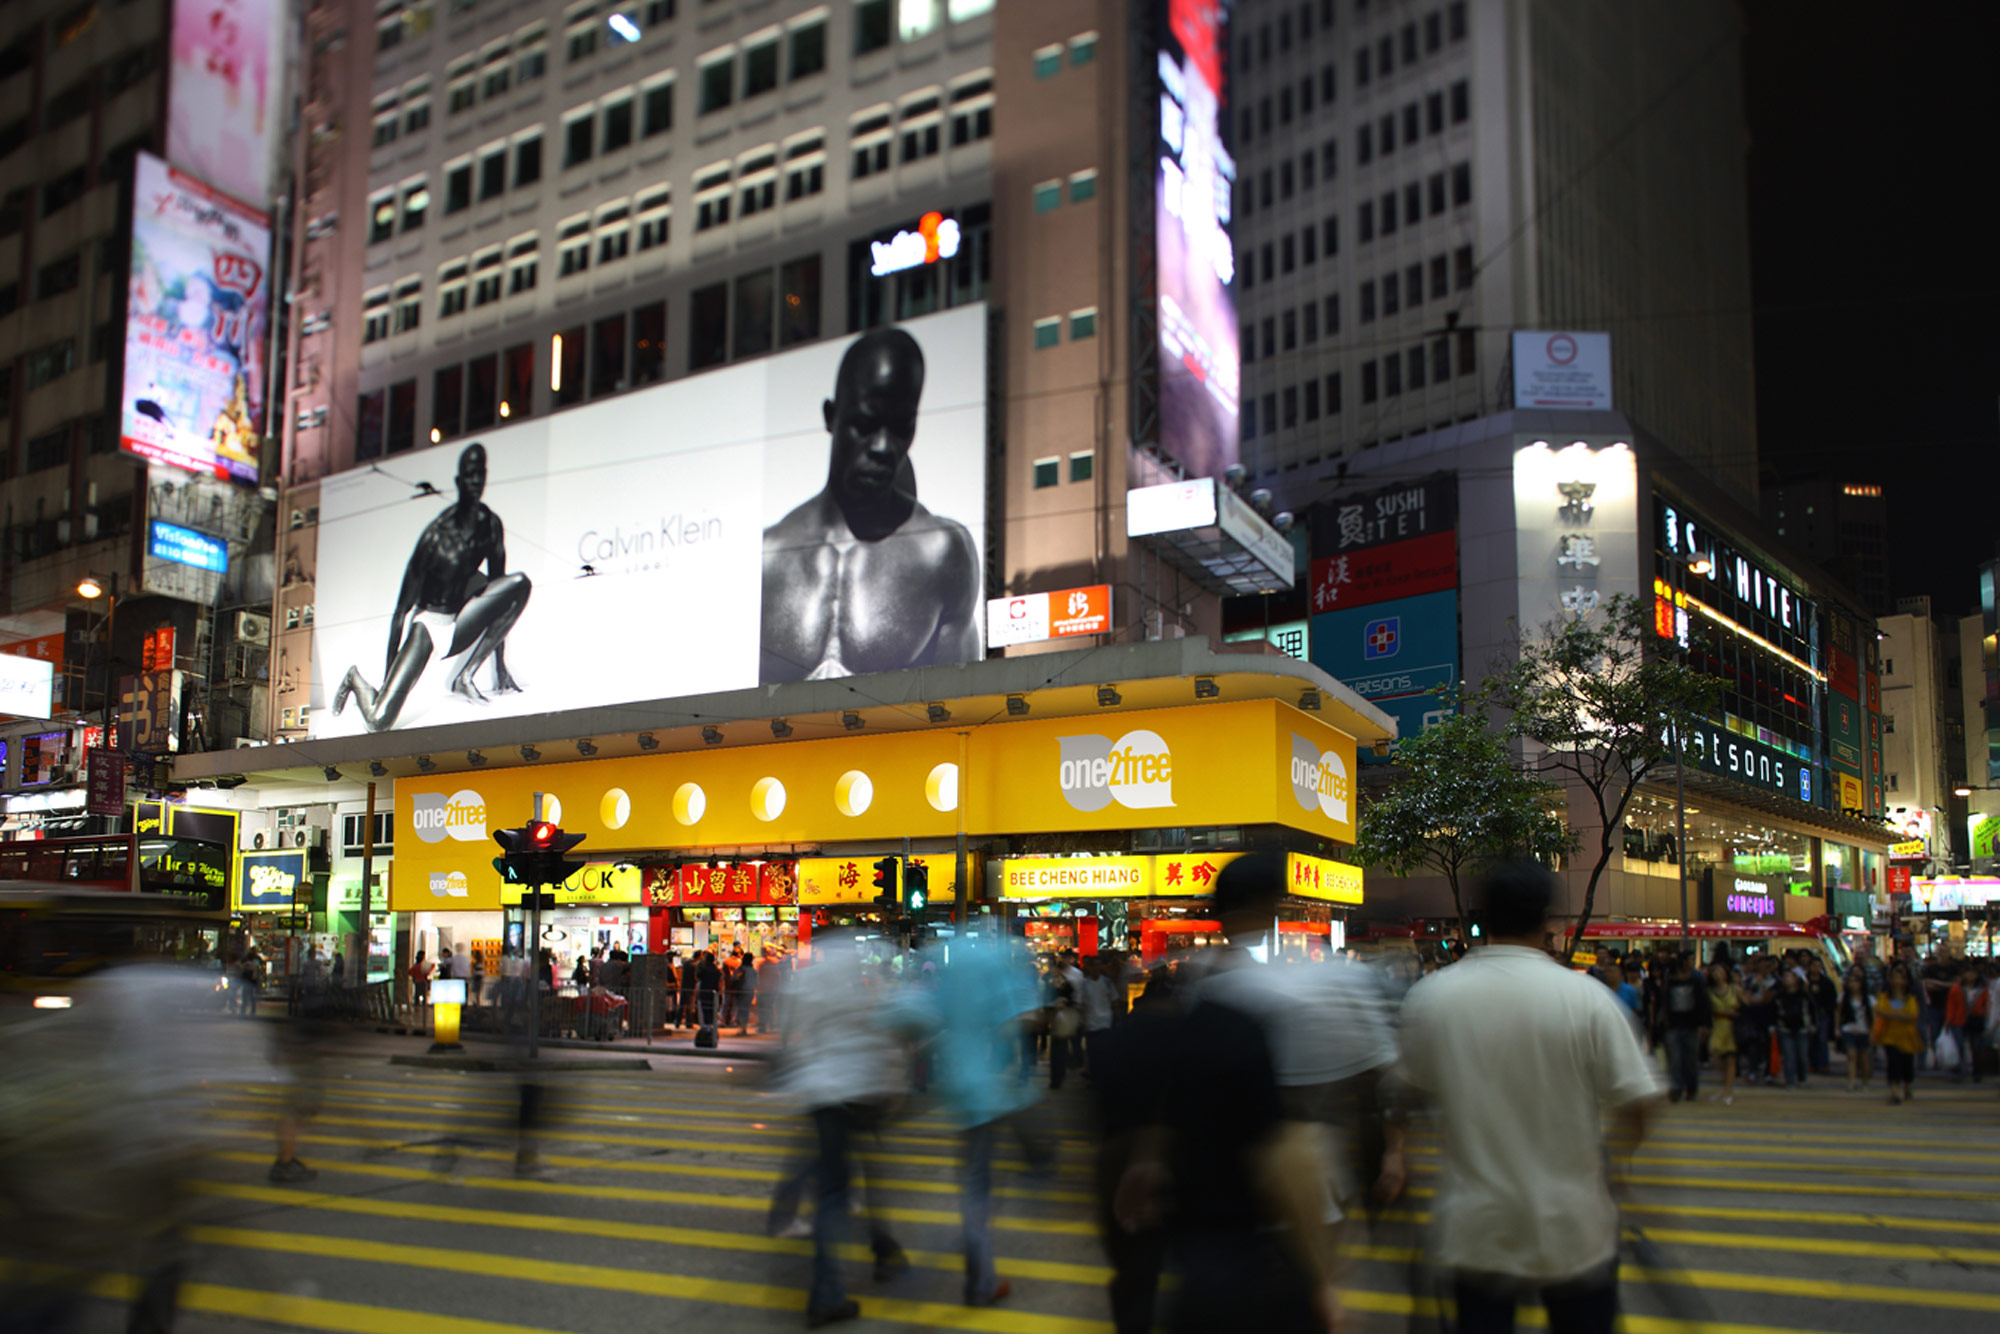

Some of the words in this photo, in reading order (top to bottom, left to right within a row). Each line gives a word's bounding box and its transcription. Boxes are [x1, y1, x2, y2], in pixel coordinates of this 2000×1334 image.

[1376, 487, 1425, 518] SUSHI
[578, 522, 653, 563] Calvin
[661, 508, 722, 547] Klein
[1060, 746, 1172, 790] one2free
[1291, 756, 1348, 802] one2free
[413, 801, 486, 829] one2free
[430, 875, 467, 890] one2free
[1010, 872, 1036, 886] BEE
[1040, 870, 1088, 885] CHENG
[1093, 868, 1140, 884] HIANG
[1727, 894, 1775, 918] concepts
